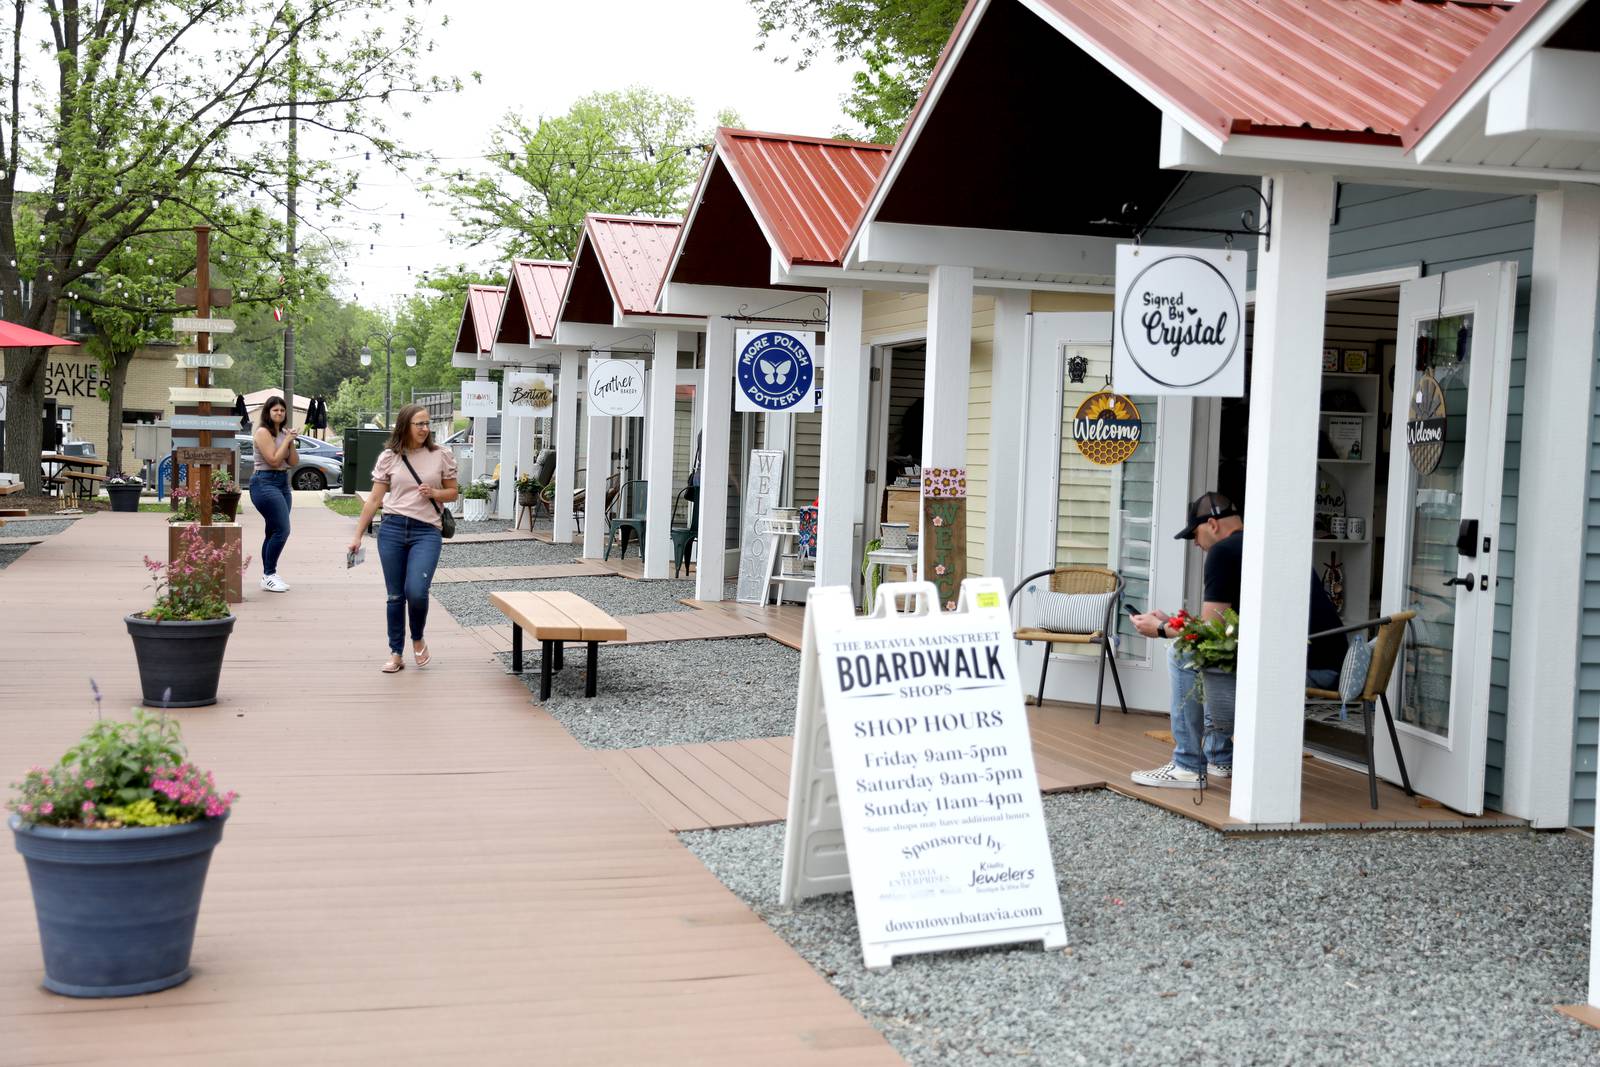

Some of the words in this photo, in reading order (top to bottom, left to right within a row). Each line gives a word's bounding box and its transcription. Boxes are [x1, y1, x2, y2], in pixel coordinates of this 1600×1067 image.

[1142, 291, 1184, 309] Signed
[1168, 306, 1185, 324] By
[1141, 311, 1228, 357] Crystal
[742, 336, 770, 366] MORE
[774, 335, 809, 367] POLISH
[593, 375, 635, 399] Gather
[747, 385, 802, 407] POTTERY
[1073, 415, 1141, 441] Welcome
[1406, 420, 1443, 445] Welcome
[930, 502, 960, 601] WELC
[833, 641, 862, 652] THE
[864, 638, 916, 650] BATAVIA
[919, 631, 1001, 647] MAINSTREET
[836, 644, 1006, 693] BOARDWALK
[899, 683, 953, 699] SHOPS
[853, 716, 918, 739] SHOP
[924, 709, 1004, 733] HOURS
[864, 750, 919, 769] Friday
[924, 744, 1008, 763] 9am-5pm
[856, 773, 934, 793] Saturday
[939, 767, 1023, 786] 9am-5pm
[864, 798, 930, 818] Sunday
[936, 790, 1024, 811] 11am-4pm
[893, 821, 918, 832] shops
[939, 817, 960, 827] have
[961, 813, 1004, 825] additional
[1005, 811, 1031, 821] hours
[901, 832, 982, 860] Sponsored
[986, 834, 1005, 855] by
[968, 866, 1035, 888] Jewelers
[884, 905, 1043, 933] downtownbatavia.com
